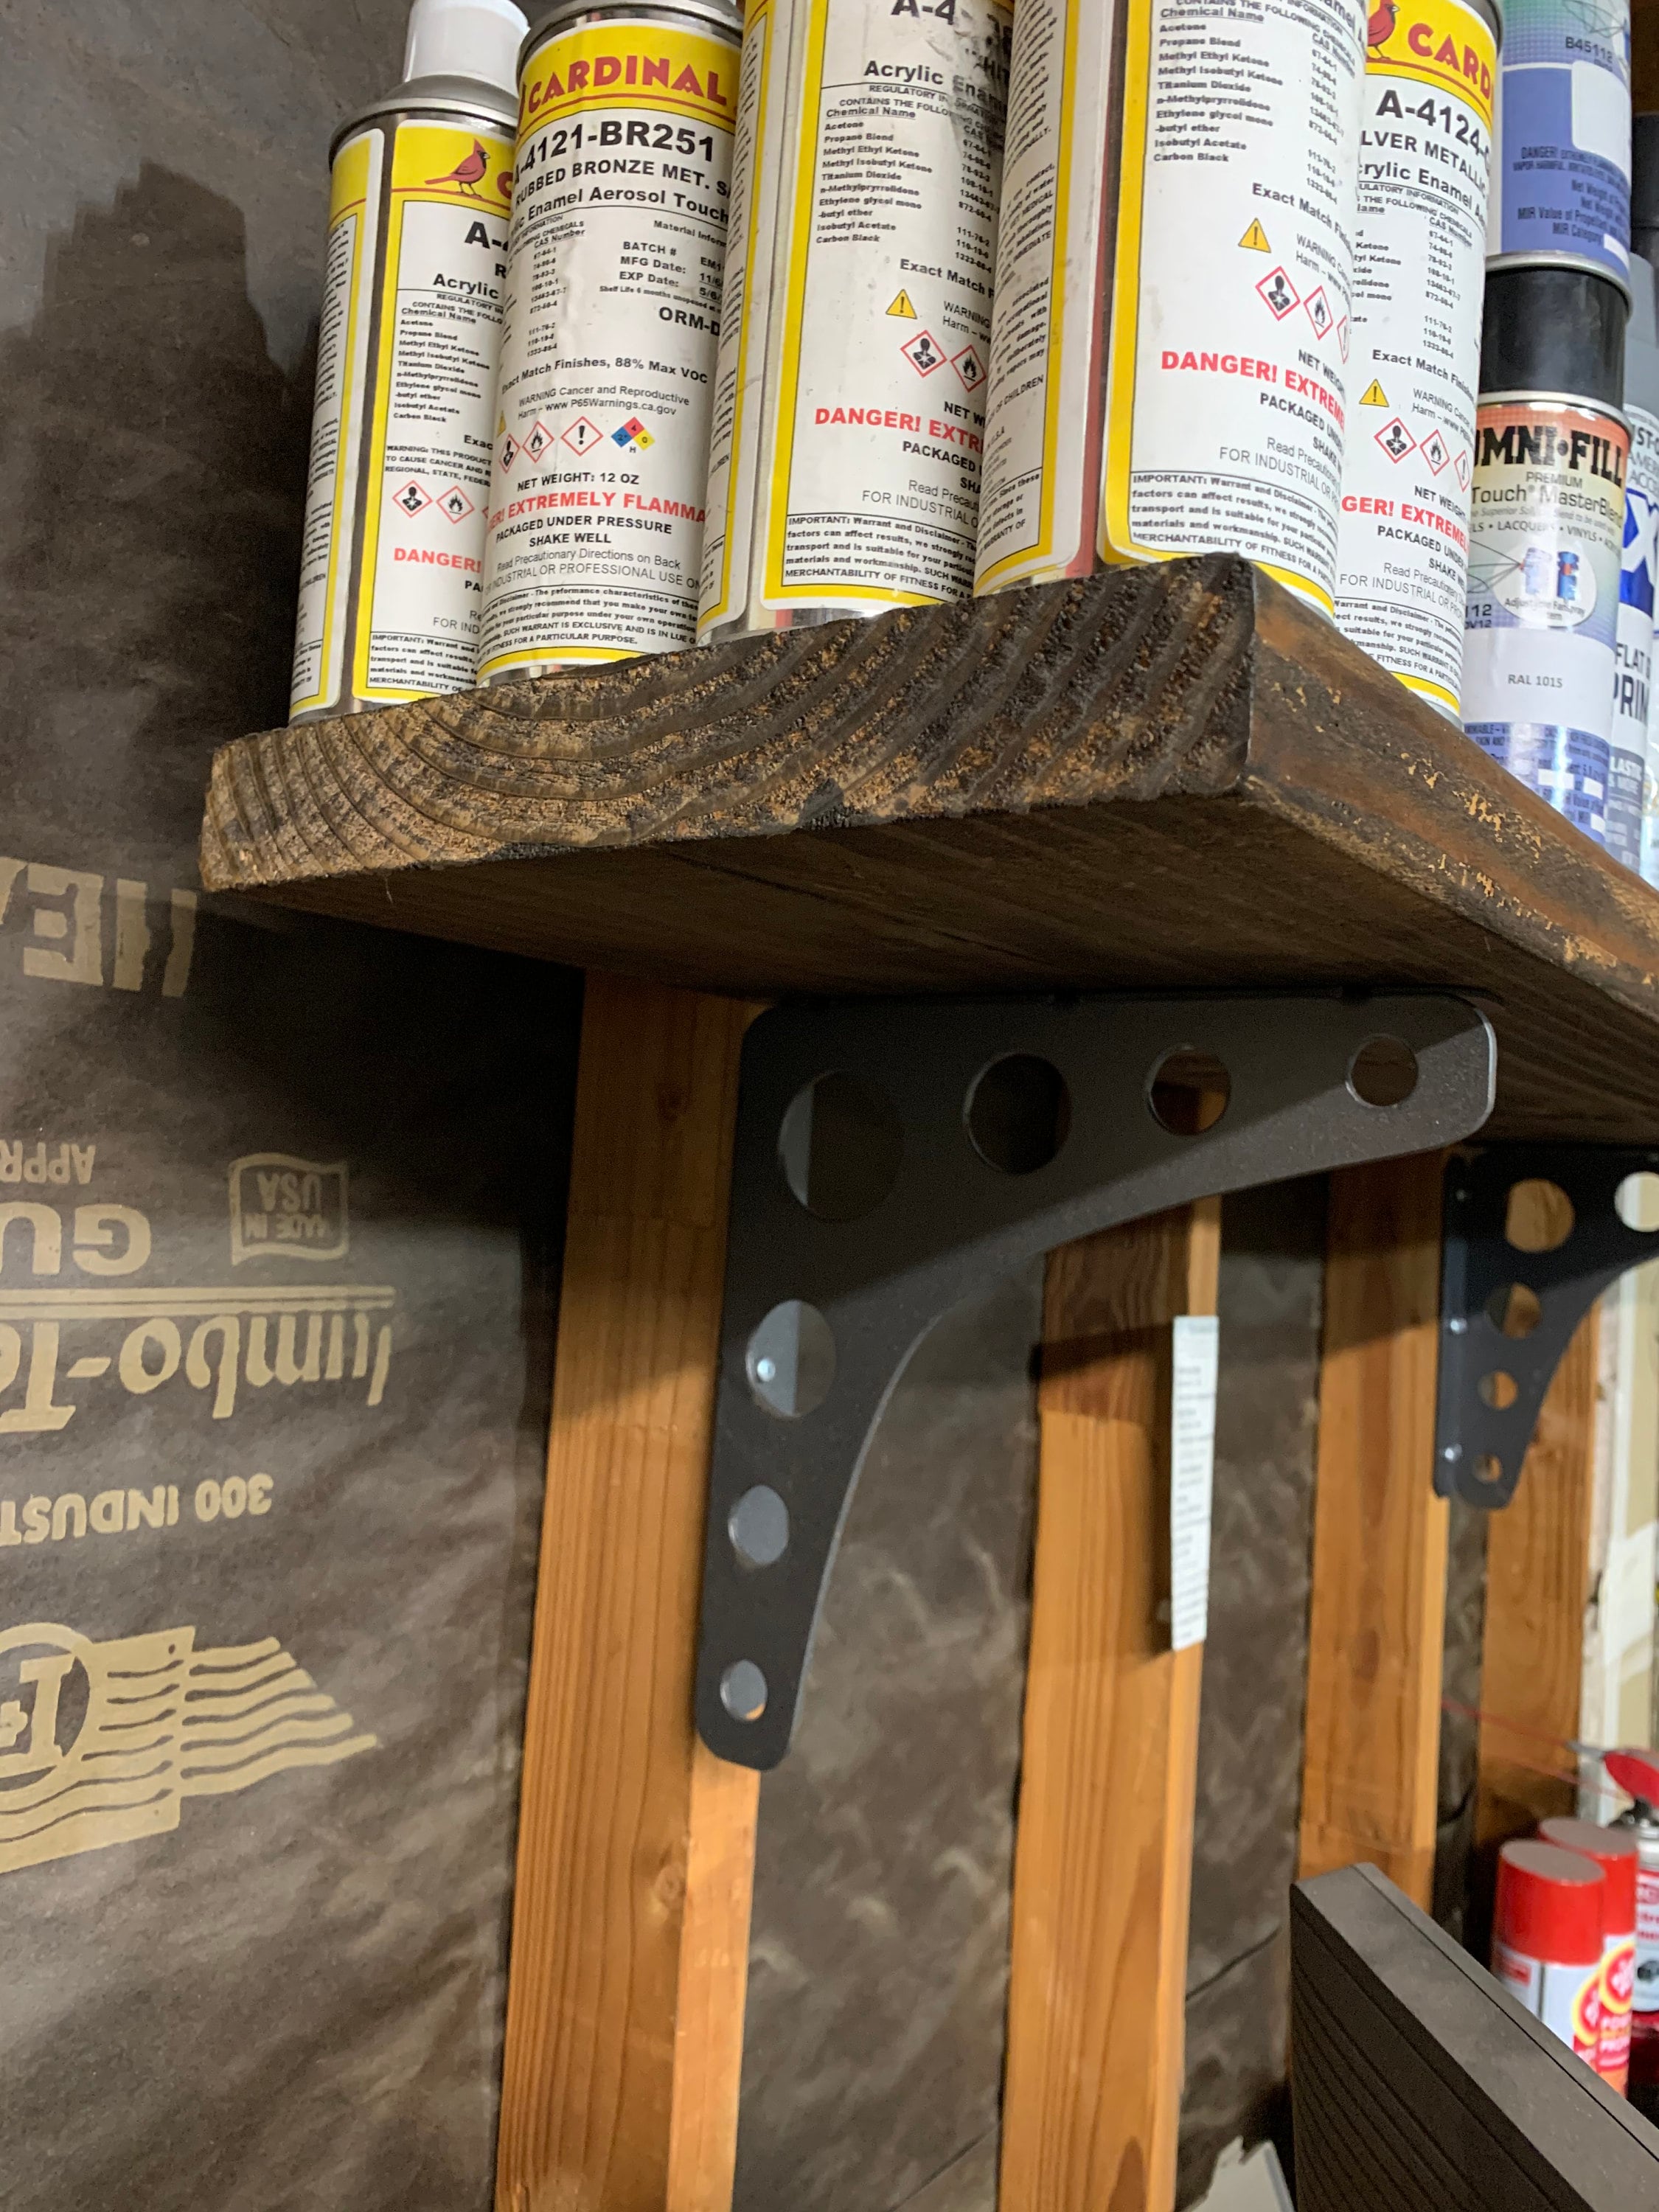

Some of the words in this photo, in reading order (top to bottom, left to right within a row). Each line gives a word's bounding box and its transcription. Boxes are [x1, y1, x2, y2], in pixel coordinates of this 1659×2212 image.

[1161, 7, 1224, 18] Chemical
[1228, 8, 1264, 21] Name
[1265, 4, 1321, 32] FOLLOWING
[1160, 24, 1206, 32] Acetone
[1565, 36, 1613, 63] B45112
[1232, 55, 1270, 66] Ketone
[863, 60, 944, 85] Acrylic
[1248, 71, 1283, 86] Ketone
[528, 55, 727, 114] CARDINAL
[869, 86, 935, 99] REGULATORY
[827, 107, 879, 118] Chemical
[883, 107, 916, 118] Name
[839, 97, 890, 106] CONTAINS
[894, 99, 914, 108] THE
[825, 122, 863, 131] Acetone
[1203, 139, 1247, 150] Acetate
[1154, 153, 1194, 161] Carbon
[1197, 153, 1229, 161] Black
[572, 159, 655, 178] BRONZE
[662, 164, 709, 189] MET.
[1419, 168, 1472, 210] Enamel
[528, 189, 582, 221] Enamel
[590, 187, 665, 204] Aerosol
[673, 193, 730, 223] Touch
[1253, 182, 1295, 206] Exact
[1299, 198, 1333, 229] Match
[1364, 195, 1382, 205] THE
[1386, 198, 1437, 218] FOLLOWING
[1406, 189, 1458, 215] INFORMATION
[653, 220, 695, 237] Material
[1429, 218, 1446, 231] CAS
[551, 229, 585, 242] Number
[623, 241, 665, 254] BATCH
[1296, 234, 1335, 268] WARNING
[620, 256, 648, 266] MFG
[653, 259, 686, 274] Date:
[1296, 250, 1319, 274] Harm
[433, 274, 499, 299] Acrylic
[619, 271, 644, 281] EXP
[647, 274, 679, 288] Date:
[900, 258, 943, 278] Exact
[947, 270, 985, 295] Match
[412, 302, 455, 312] CONTAINS
[437, 293, 493, 311] REGULATORY
[401, 307, 446, 318] Chemical
[449, 311, 476, 324] Name
[659, 307, 720, 336] ORM-D
[942, 316, 969, 333] Harm
[944, 301, 991, 329] WARNING
[1161, 351, 1277, 383] DANGER!
[1298, 349, 1320, 370] NET
[1372, 349, 1412, 366] Exact
[1416, 358, 1449, 380] Match
[521, 364, 551, 380] Match
[554, 358, 610, 370] Finishes,
[615, 358, 644, 369] 88%
[649, 361, 676, 375] Max
[681, 369, 708, 383] VOC
[519, 389, 556, 408] WARNING
[559, 386, 594, 397] Cancer
[598, 386, 616, 394] and
[619, 386, 689, 406] Reproductive
[1413, 388, 1453, 413] WARNING
[815, 408, 921, 432] DANGER!
[945, 401, 970, 419] NET
[1260, 392, 1324, 431] PACKAGED
[1412, 403, 1436, 420] Harm
[902, 441, 975, 472] PACKAGED
[1267, 437, 1294, 457] Read
[430, 458, 464, 470] CANCER
[1220, 447, 1250, 464] FOR
[1255, 453, 1320, 490] INDUSTRIAL
[518, 479, 537, 492] NET
[541, 472, 594, 486] WEIGHT:
[599, 473, 615, 482] 12
[621, 474, 639, 484] OZ
[908, 479, 938, 497] Read
[1133, 474, 1207, 484] IMPORTANT:
[1211, 477, 1251, 491] Warrant
[1526, 471, 1583, 490] PREMIUM
[1132, 490, 1173, 498] factors
[1201, 491, 1233, 502] affect
[1414, 485, 1436, 503] NET
[508, 492, 616, 518] EXTREMELY
[862, 490, 891, 505] FOR
[896, 494, 969, 524] INDUSTRIAL
[1132, 505, 1184, 515] transport
[496, 519, 543, 543] PACKAGED
[547, 515, 592, 526] UNDER
[597, 517, 672, 535] PRESSURE
[787, 530, 820, 538] factors
[845, 529, 873, 539] affect
[877, 533, 912, 546] results,
[789, 515, 850, 526] IMPORTANT:
[853, 516, 891, 529] Warrant
[915, 526, 960, 544] Disclaimer
[1132, 519, 1185, 529] materials
[1213, 522, 1280, 543] workmanship.
[1377, 526, 1441, 552] PACKAGED
[1567, 526, 1597, 542] VINYLS
[529, 533, 569, 547] SHAKE
[574, 533, 611, 544] WELL
[787, 542, 830, 552] transport
[1133, 532, 1242, 548] MERCHANTABILITY
[1261, 544, 1297, 563] FITNESS
[394, 547, 481, 574] DANGER!
[515, 550, 576, 566] Precautionary
[580, 549, 633, 562] Directions
[637, 554, 650, 563] on
[654, 556, 681, 570] Back
[786, 555, 830, 565] materials
[854, 557, 921, 574] workmanship.
[925, 567, 949, 580] SUCH
[1384, 562, 1411, 577] Read
[1428, 558, 1455, 581] SHAKE
[540, 564, 556, 575] OR
[560, 563, 655, 580] PROFESSIONAL
[659, 572, 683, 585] USE
[785, 568, 880, 579] MERCHANTABILITY
[900, 574, 939, 590] FITNESS
[603, 588, 669, 603] characteristics
[1340, 574, 1368, 587] FOR
[1372, 577, 1436, 603] INDUSTRIAL
[434, 617, 456, 630] FOR
[522, 622, 559, 634] WARRANT
[572, 622, 623, 631] EXCLUSIVE
[372, 634, 424, 644] IMPORTANT:
[536, 633, 589, 641] PARTICULAR
[591, 633, 638, 644] PURPOSE.
[1377, 654, 1411, 667] FITNESS
[369, 677, 448, 691] MERCHANTABILITY
[1508, 675, 1531, 684] RAL
[1536, 676, 1562, 688] 1015
[257, 1171, 322, 1212] USA
[245, 1213, 268, 1239] IN
[195, 1474, 274, 1523] 300
